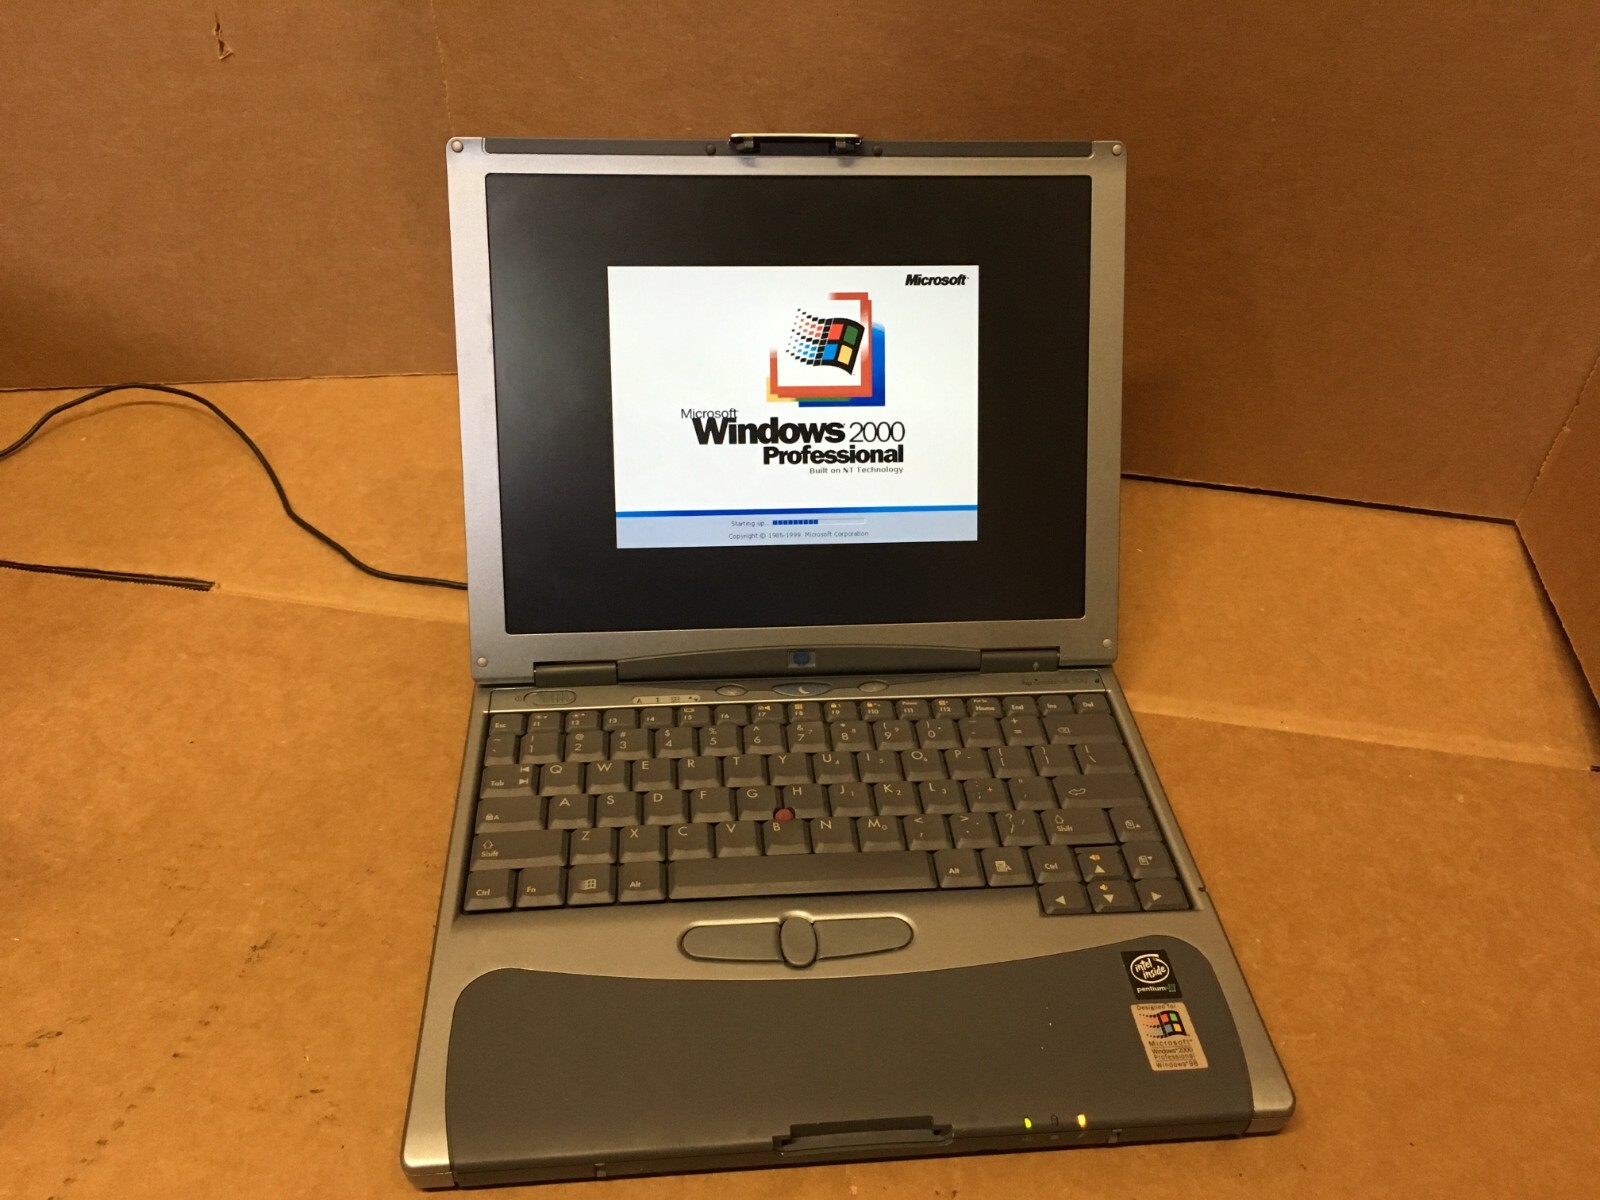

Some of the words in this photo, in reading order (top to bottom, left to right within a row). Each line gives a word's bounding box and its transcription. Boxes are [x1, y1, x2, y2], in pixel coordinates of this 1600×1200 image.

[905, 274, 967, 286] Microsoft
[680, 408, 738, 419] Microsoft
[692, 416, 846, 445] Windows
[849, 421, 906, 443] 2000
[763, 444, 904, 465] Professional
[857, 466, 904, 475] Technology
[823, 754, 831, 762] U
[912, 751, 923, 759] O
[955, 750, 961, 758] P
[733, 757, 740, 765] T
[779, 756, 786, 764] Y
[597, 763, 612, 771] W
[642, 761, 649, 769] E
[550, 765, 562, 774] Q
[793, 787, 802, 795] H
[840, 786, 844, 794] J
[929, 783, 935, 791] L
[654, 794, 663, 802] D
[701, 791, 707, 799] F
[747, 790, 758, 798] G
[560, 798, 570, 806] A
[607, 796, 614, 804] S
[773, 823, 780, 831] B
[821, 821, 831, 829] N
[868, 819, 880, 828] M
[678, 827, 687, 835] C
[726, 824, 736, 832] V
[582, 831, 590, 840] Z
[630, 829, 638, 838] X
[1134, 958, 1152, 973] intel
[1143, 965, 1167, 980] inside
[1136, 985, 1166, 994] pentium
[1148, 1039, 1188, 1047] Microsoft
